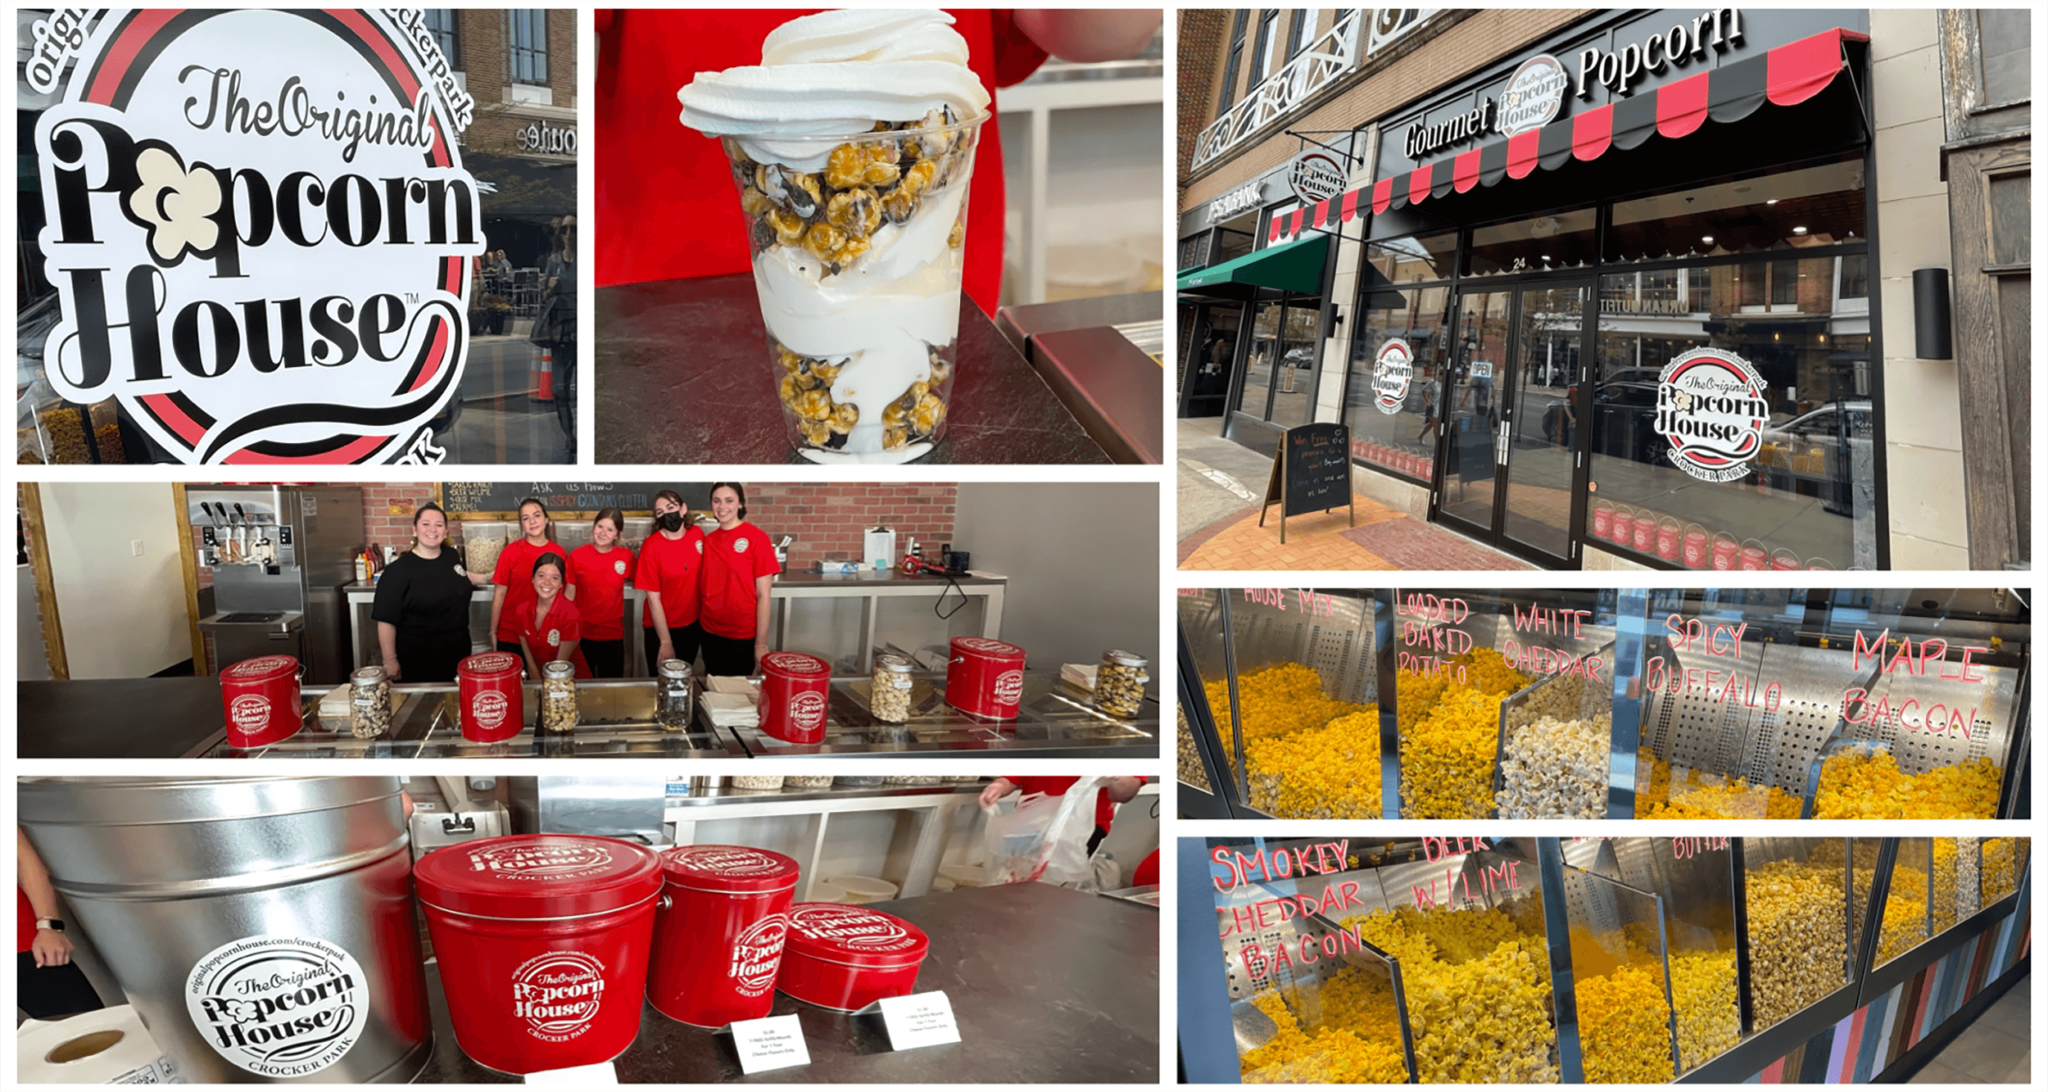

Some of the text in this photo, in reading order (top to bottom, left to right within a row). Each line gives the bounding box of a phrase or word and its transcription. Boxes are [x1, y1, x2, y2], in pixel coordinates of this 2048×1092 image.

[33, 9, 89, 86] origi
[1576, 9, 1744, 97] Popcorn
[391, 9, 470, 122] ckerpark
[1501, 74, 1566, 110] Popcorn
[1404, 96, 1490, 158] Gourmet
[1496, 100, 1548, 130] House
[1293, 173, 1335, 195] House
[1294, 161, 1347, 188] Popcorn
[51, 117, 479, 278] Popcorn
[1513, 257, 1526, 269] 24
[58, 264, 407, 389] House
[1372, 376, 1402, 391] House
[1374, 361, 1412, 378] Popcorn
[1473, 362, 1491, 377] OPEN
[1660, 384, 1766, 417] Popcorn
[1656, 409, 1740, 442] House
[1668, 449, 1749, 481] CROCKER PARK
[531, 482, 553, 493] Ask
[565, 482, 580, 491] us
[1300, 588, 1334, 617] MIX
[1396, 588, 1468, 625] LOADED
[1404, 621, 1472, 655] BAKED
[1513, 602, 1592, 640] WHITE
[1666, 613, 1748, 659] SPICY
[1399, 652, 1466, 685] POTATO
[1503, 640, 1604, 684] CHEDDAR
[1852, 627, 1989, 684] MAPLE
[1647, 656, 1782, 713] BUFFALO
[1843, 687, 1977, 740] BACON
[1421, 837, 1490, 863] BEER
[1672, 837, 1730, 860] BUTTER
[1211, 839, 1349, 894] SMOKEY
[801, 925, 886, 939] House
[192, 937, 346, 995] originalpopcornhouse.com/crockerpark
[1239, 924, 1363, 980] BACON
[201, 973, 355, 1023] Popcorn
[513, 979, 605, 1004] Popcorn
[513, 1001, 587, 1018] House
[216, 1009, 333, 1048] House
[527, 1023, 592, 1042] CROCKER PARK
[248, 1037, 353, 1076] CROCKER PARK
